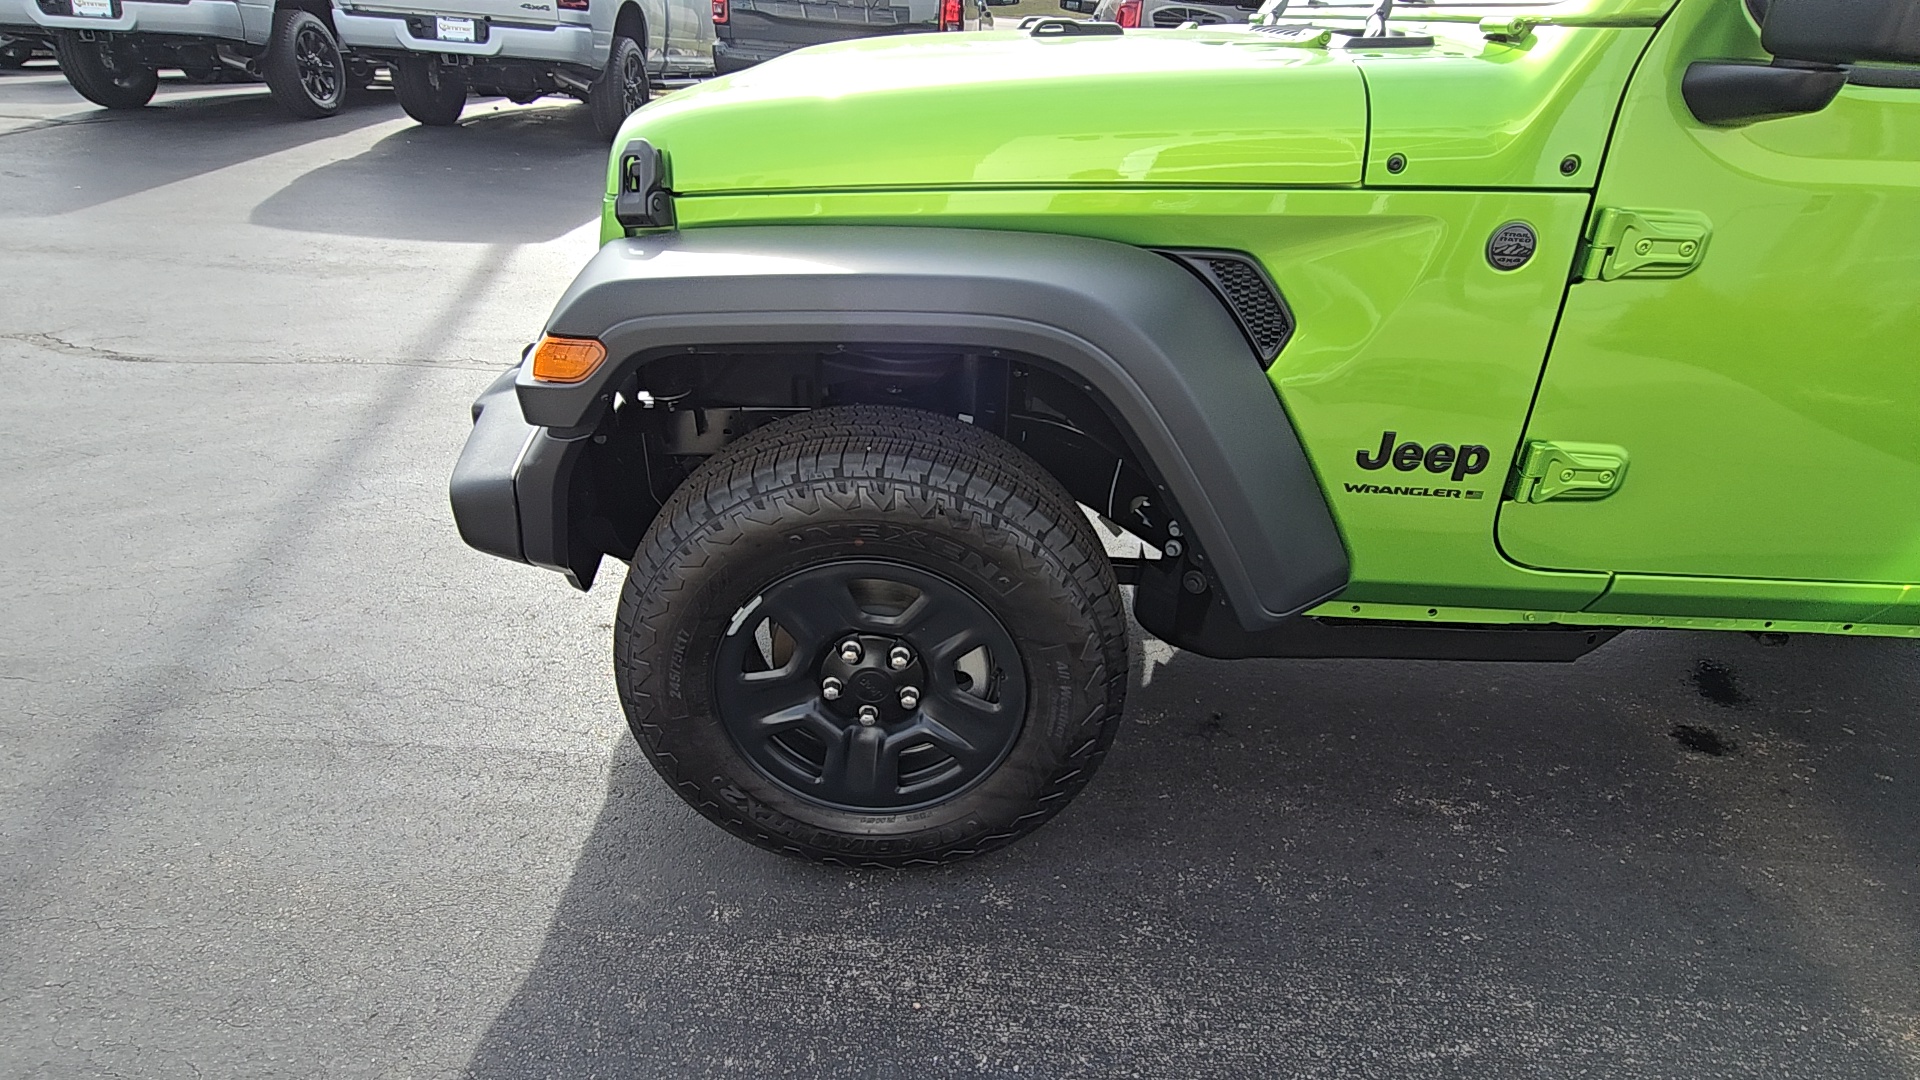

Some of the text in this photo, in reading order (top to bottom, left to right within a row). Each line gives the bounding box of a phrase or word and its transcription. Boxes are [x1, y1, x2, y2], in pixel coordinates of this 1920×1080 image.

[1356, 431, 1490, 481] Jeep
[1343, 483, 1462, 499] WRANGLER
[669, 628, 690, 699] 245/75R17
